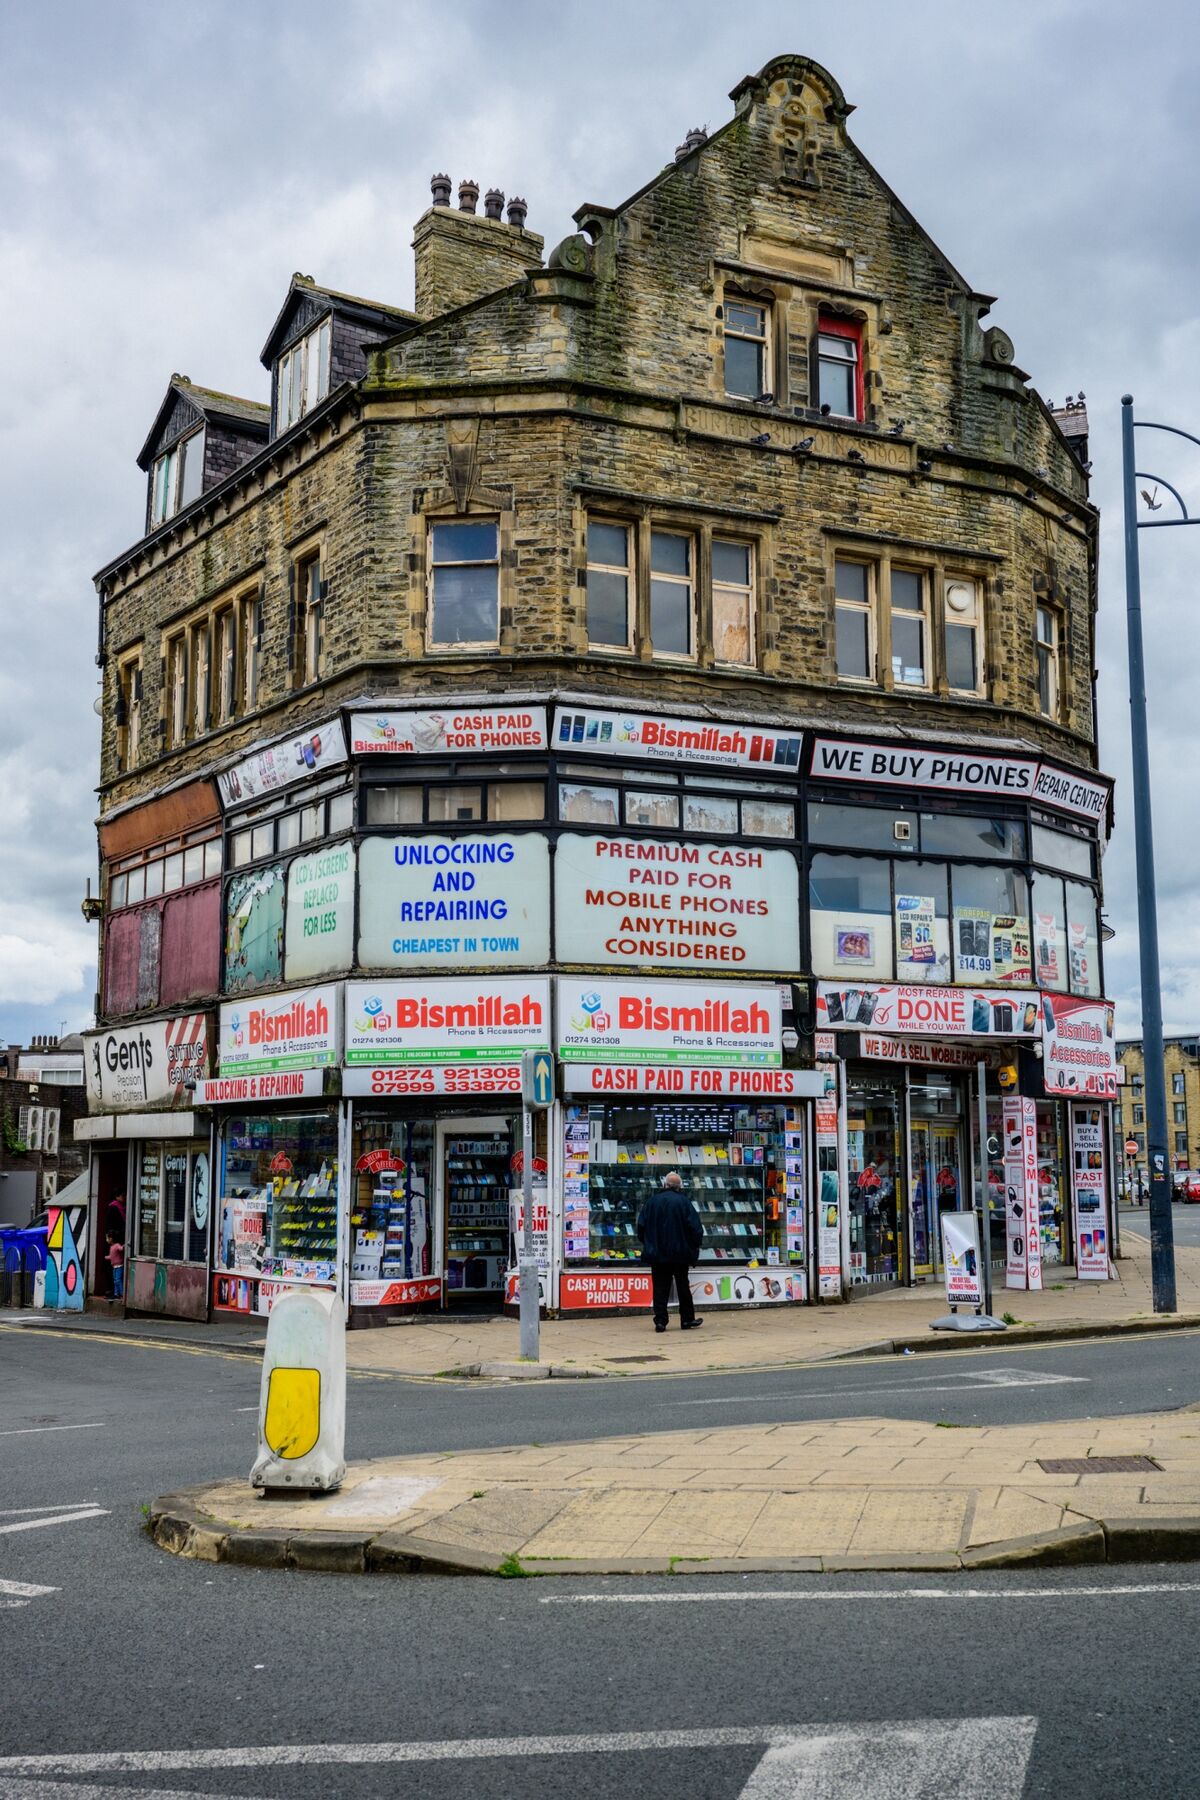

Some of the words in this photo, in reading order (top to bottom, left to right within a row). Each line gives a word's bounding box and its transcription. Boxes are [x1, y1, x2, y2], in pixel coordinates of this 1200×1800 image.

[871, 446, 909, 466] 1904
[453, 715, 493, 731] CASH
[497, 714, 533, 729] PAID
[354, 739, 414, 753] Bismillah
[446, 732, 479, 748] FOR
[482, 731, 542, 746] PHONES
[641, 721, 747, 754] Bismillah
[647, 746, 675, 759] Phone
[677, 750, 683, 758] &
[685, 751, 738, 764] Accessories
[821, 747, 864, 772] WE
[871, 753, 925, 778] BUY
[930, 759, 1031, 788] PHONES
[1035, 772, 1070, 802] REPAIR
[1069, 784, 1105, 813] CENTRE
[395, 843, 514, 866] UNLOCKING
[596, 841, 699, 864] PREMIUM
[708, 850, 763, 868] CASH
[433, 872, 475, 892] AND
[629, 868, 679, 886] PAID
[688, 873, 732, 890] FOR
[304, 887, 338, 909] REPLACED
[585, 889, 671, 910] MOBILE
[680, 896, 769, 916] PHONES
[401, 900, 508, 922] REPAIRING
[303, 917, 319, 938] FOR
[320, 912, 337, 935] LESS
[619, 917, 737, 938] ANYTHING
[915, 927, 930, 943] 30
[393, 939, 460, 954] CHEAPEST
[464, 938, 477, 952] IN
[481, 937, 519, 952] TOWN
[605, 938, 746, 962] CONSIDERED
[960, 958, 991, 971] £14.99
[898, 988, 923, 997] MOST
[925, 988, 965, 999] REPAIRS
[396, 994, 542, 1029] Bismillah
[618, 997, 770, 1034] Bismillah
[897, 999, 966, 1022] DONE
[248, 997, 328, 1045] Bismillah
[897, 1021, 925, 1030] WHILE
[926, 1023, 943, 1031] YOU
[945, 1023, 966, 1032] WAIT
[1057, 1018, 1103, 1043] Bismillah
[448, 1028, 476, 1036] Phone
[478, 1027, 485, 1035] &
[487, 1027, 542, 1035] Accessories
[565, 1035, 589, 1044] 01274
[591, 1036, 620, 1045] 921308
[816, 1036, 833, 1044] FAST
[167, 1041, 204, 1062] CUTTING
[263, 1043, 281, 1056] Phone
[283, 1041, 288, 1053] &
[288, 1039, 328, 1052] Accessories
[673, 1036, 704, 1046] Phone
[707, 1037, 713, 1046] &
[716, 1037, 774, 1048] Accessories
[865, 1039, 879, 1055] WE
[882, 1041, 900, 1057] BUY
[901, 1043, 908, 1058] &
[909, 1044, 930, 1061] SELL
[931, 1046, 961, 1064] MOBILE
[1050, 1041, 1111, 1068] Accessories
[106, 1032, 152, 1100] Gents
[372, 1070, 434, 1082] 01274
[443, 1068, 521, 1080] 921308
[205, 1079, 247, 1101] UNLOCKING
[250, 1078, 256, 1098] &
[260, 1073, 304, 1096] REPAIRING
[371, 1082, 435, 1093] 07999
[444, 1080, 521, 1092] 333870
[592, 1068, 638, 1090] CASH
[644, 1069, 684, 1091] PAID
[691, 1070, 723, 1092] FOR
[729, 1071, 794, 1093] PHONES
[1075, 1172, 1103, 1181] FAST
[1026, 1125, 1038, 1253] BISMILLAH
[537, 1206, 547, 1217] FI
[243, 1218, 262, 1233] DONE
[262, 1282, 274, 1297] BUY
[567, 1278, 597, 1291] CASH
[599, 1277, 625, 1291] PAID
[627, 1277, 649, 1290] FOR
[586, 1291, 630, 1304] PHONES
